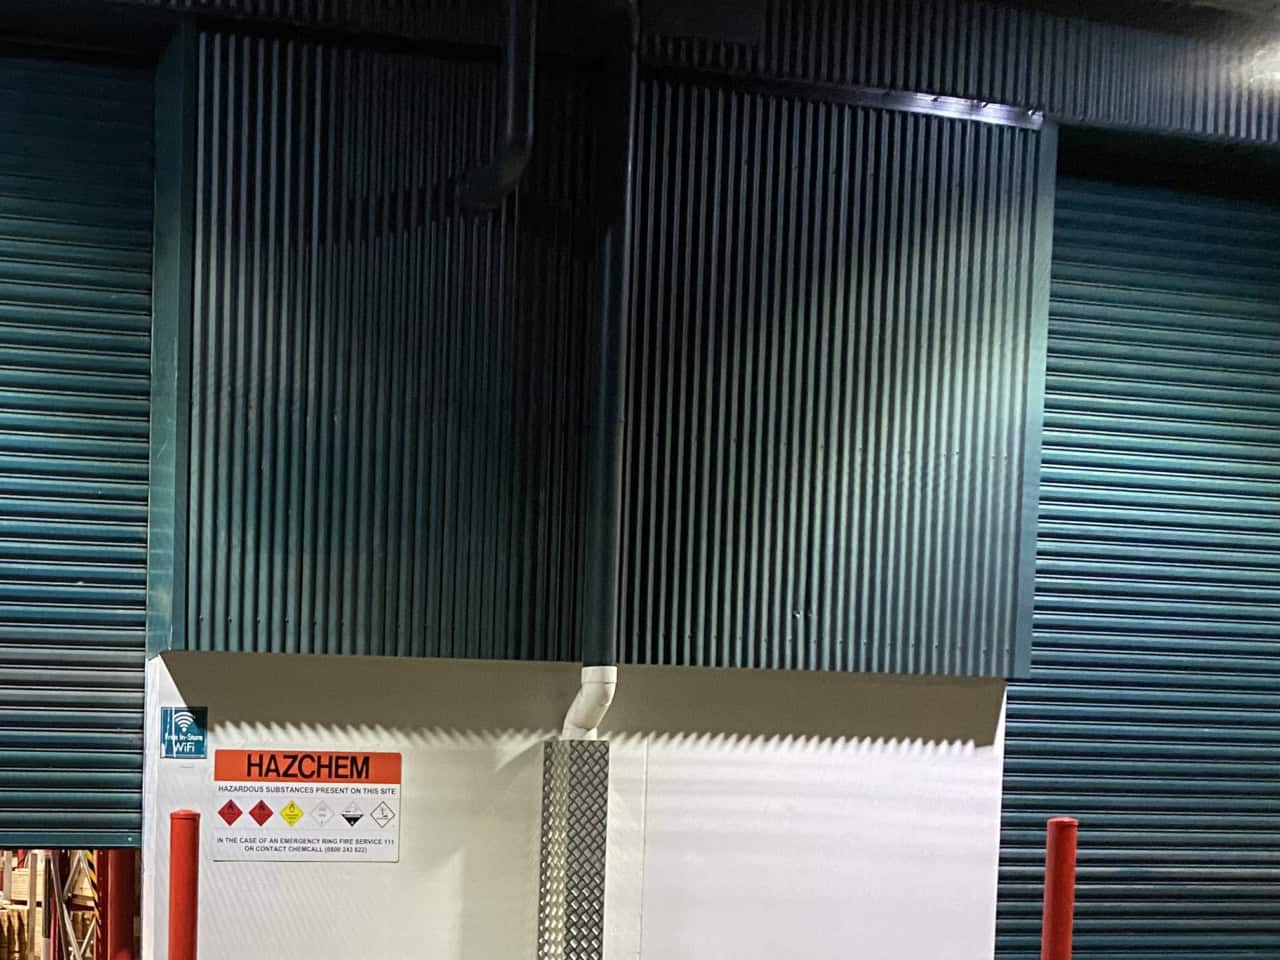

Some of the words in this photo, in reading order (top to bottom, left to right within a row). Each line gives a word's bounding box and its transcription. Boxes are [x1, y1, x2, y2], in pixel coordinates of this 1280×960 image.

[175, 742, 195, 753] WiFi
[247, 754, 370, 779] HAZCHEM
[218, 785, 264, 793] HAZARDOUS
[266, 786, 314, 794] SUBSTANCES
[363, 787, 379, 795] THIS
